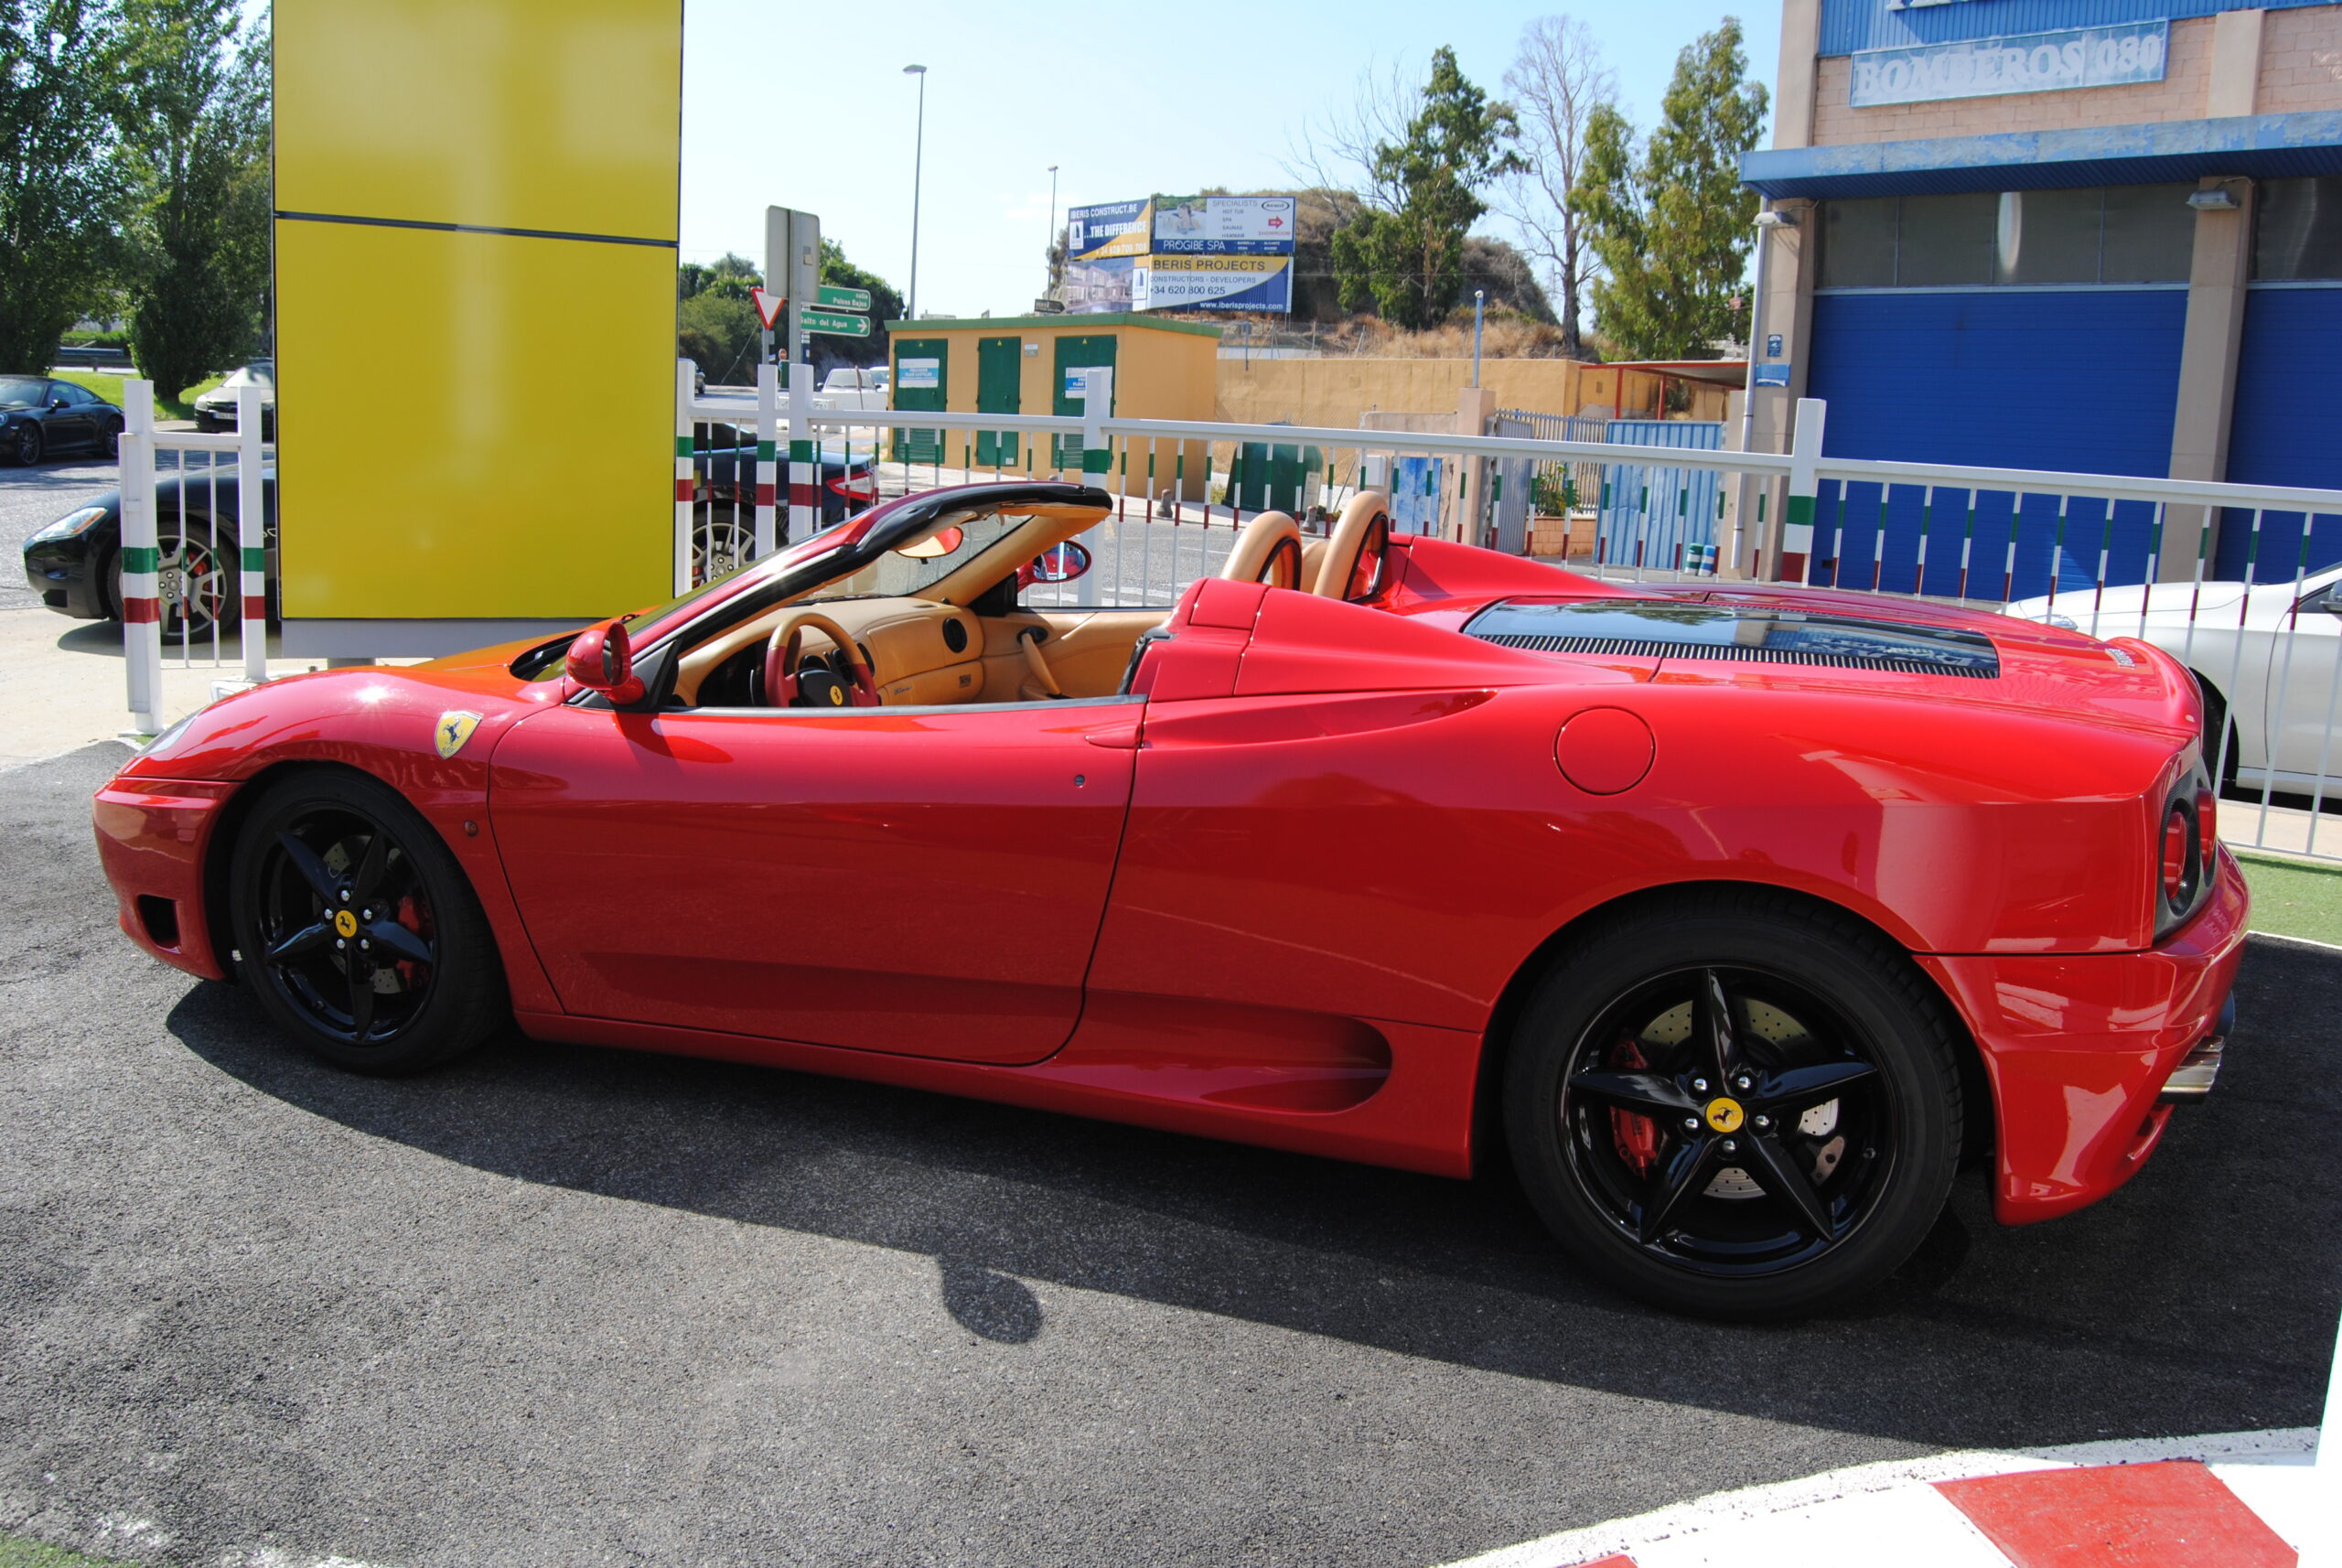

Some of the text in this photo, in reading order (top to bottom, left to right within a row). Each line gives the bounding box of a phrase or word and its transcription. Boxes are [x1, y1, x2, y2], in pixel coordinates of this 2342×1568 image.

[1854, 34, 2163, 92] BOMBEROS 080
[1070, 203, 1138, 220] IBERIS CONSTRUCT.BE
[1104, 220, 1147, 237] DIFFERENCE
[1163, 240, 1204, 251] PROGIBE
[1207, 240, 1226, 251] SPA
[1153, 260, 1265, 271] BERIS PROJECTS
[1168, 286, 1186, 295] 620
[1187, 286, 1206, 295] 800
[1208, 286, 1226, 295] 625
[1199, 301, 1284, 310] www.iberisprojects.com
[819, 318, 829, 327] del
[832, 319, 848, 328] Agua
